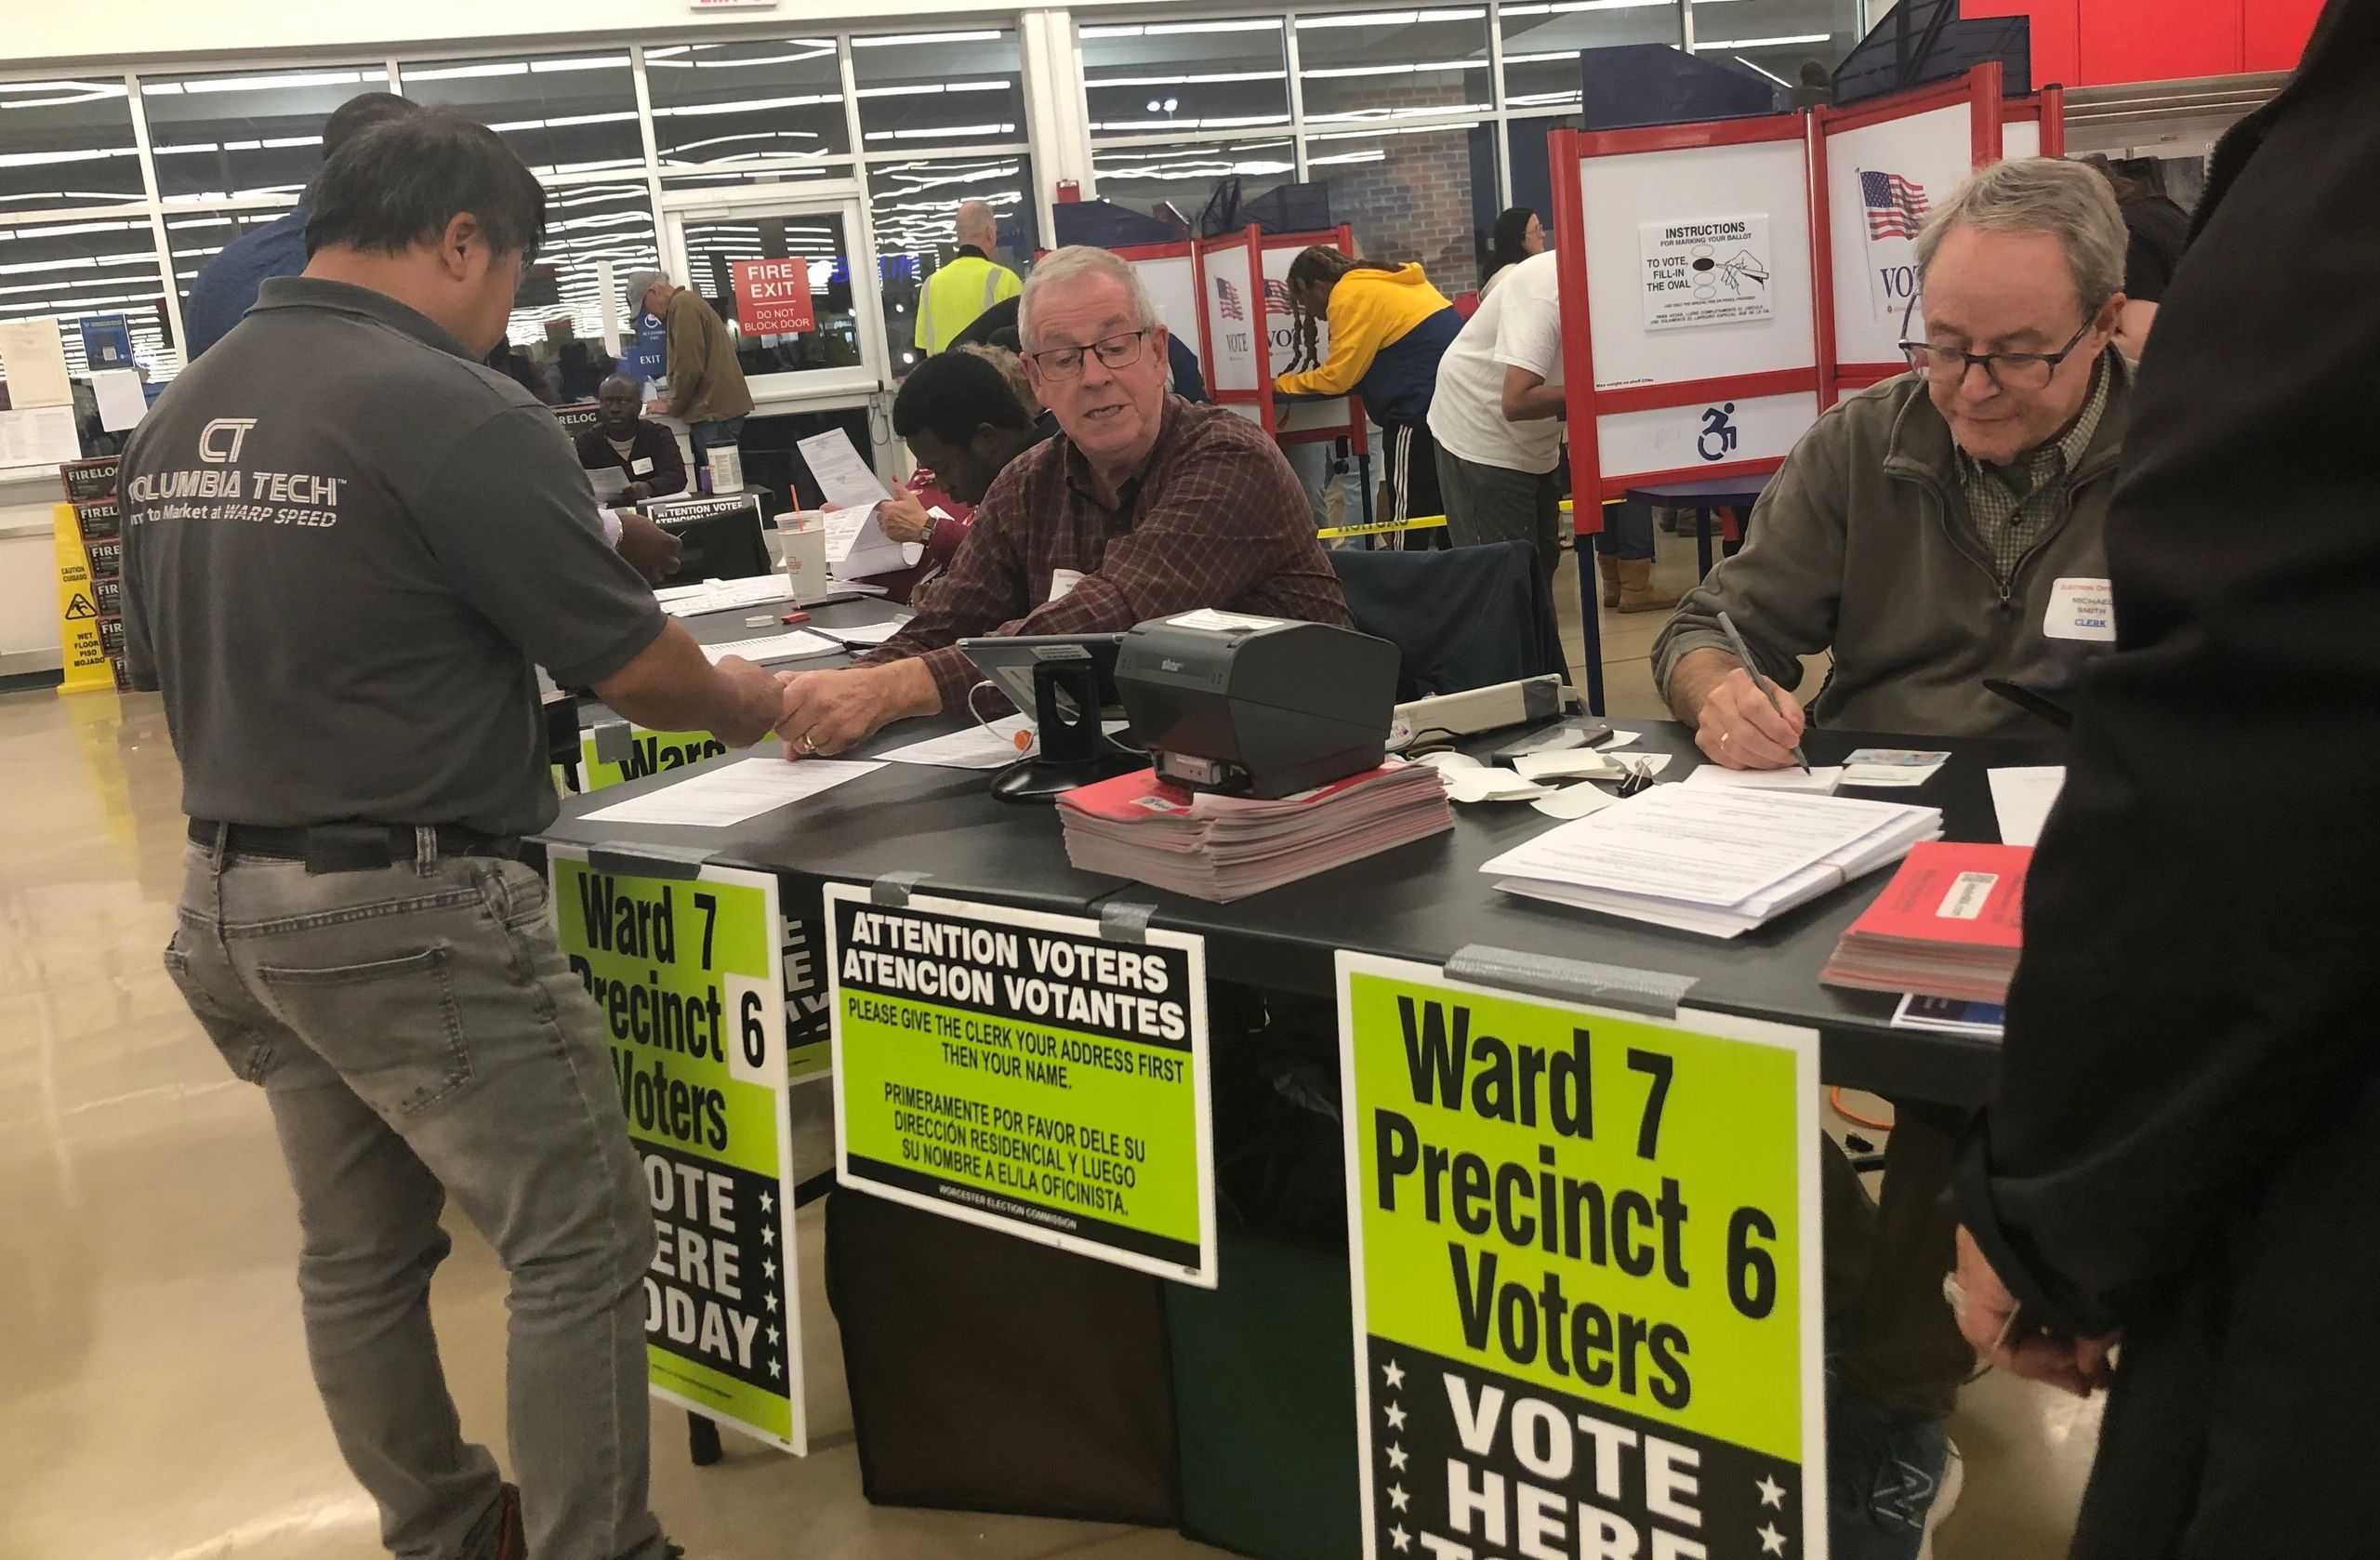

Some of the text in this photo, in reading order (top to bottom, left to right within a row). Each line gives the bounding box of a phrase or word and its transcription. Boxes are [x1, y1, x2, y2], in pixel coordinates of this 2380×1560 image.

[1665, 222, 1745, 239] INSTRUCTIONS
[1675, 237, 1706, 245] MARKING
[747, 264, 793, 280] FIRE
[1647, 258, 1659, 268] TO
[1654, 269, 1685, 279] FILL-IN
[751, 281, 794, 297] EXIT
[1646, 280, 1691, 292] THE OVAL
[1880, 266, 1919, 298] VO
[745, 318, 810, 331] BLOCK DOOR
[757, 309, 795, 319] DO NOT
[1226, 333, 1248, 352] VOTE
[1267, 329, 1294, 348] VO
[640, 354, 661, 364] EXIT
[559, 413, 596, 425] RELOG
[199, 417, 258, 463] CT
[68, 467, 119, 482] FIRELO
[80, 506, 120, 520] FIREL
[148, 508, 161, 522] to
[163, 503, 207, 520] Market
[211, 507, 221, 520] at
[224, 504, 273, 522] WARP
[274, 509, 337, 528] SPEED
[713, 501, 743, 511] VOTE
[91, 545, 120, 558] FIRE
[62, 574, 87, 582] CUIDADO
[2075, 618, 2107, 628] CLERK
[73, 640, 99, 649] FLOOR
[73, 657, 105, 667] MOJADO
[577, 872, 676, 965] Ward
[694, 892, 717, 972] 7
[851, 911, 1019, 970] ATTENTION
[1027, 937, 1169, 995] VOTERS
[842, 948, 995, 1006] ATENCION
[1003, 974, 1185, 1041] VOTANTES
[740, 990, 765, 1069] 6
[848, 997, 898, 1027] PLEASE
[902, 1008, 932, 1034] GIVE
[935, 1013, 962, 1039] THE
[966, 1020, 1012, 1050] CLERK
[1015, 1029, 1058, 1059] YOUR
[1060, 1038, 1134, 1075] ADDRESS
[1139, 1054, 1184, 1084] FIRST
[942, 1042, 1072, 1091] THEN YOUR NAME.
[1396, 994, 1674, 1161] Ward 7
[611, 1044, 729, 1152] Voters
[884, 1082, 1146, 1163] PRIMERAMENTE POR FAVOR DELE SU
[894, 1111, 1136, 1189] DIRECCIÓN RESIDENCIAL Y LUEGO
[902, 1138, 919, 1162] SU
[923, 1145, 983, 1178] NOMBRE
[985, 1161, 995, 1182] A
[1041, 1173, 1130, 1216] OFICINISTA.
[640, 1151, 736, 1235] OTE
[938, 1183, 1078, 1231] WORCESTER ELECTION COMMISSION
[1374, 1107, 1778, 1321] Precinct 6
[651, 1220, 742, 1302] ERE
[643, 1276, 760, 1369] ODAY
[1448, 1242, 1693, 1412] Voters
[1442, 1372, 1702, 1527] VOTE
